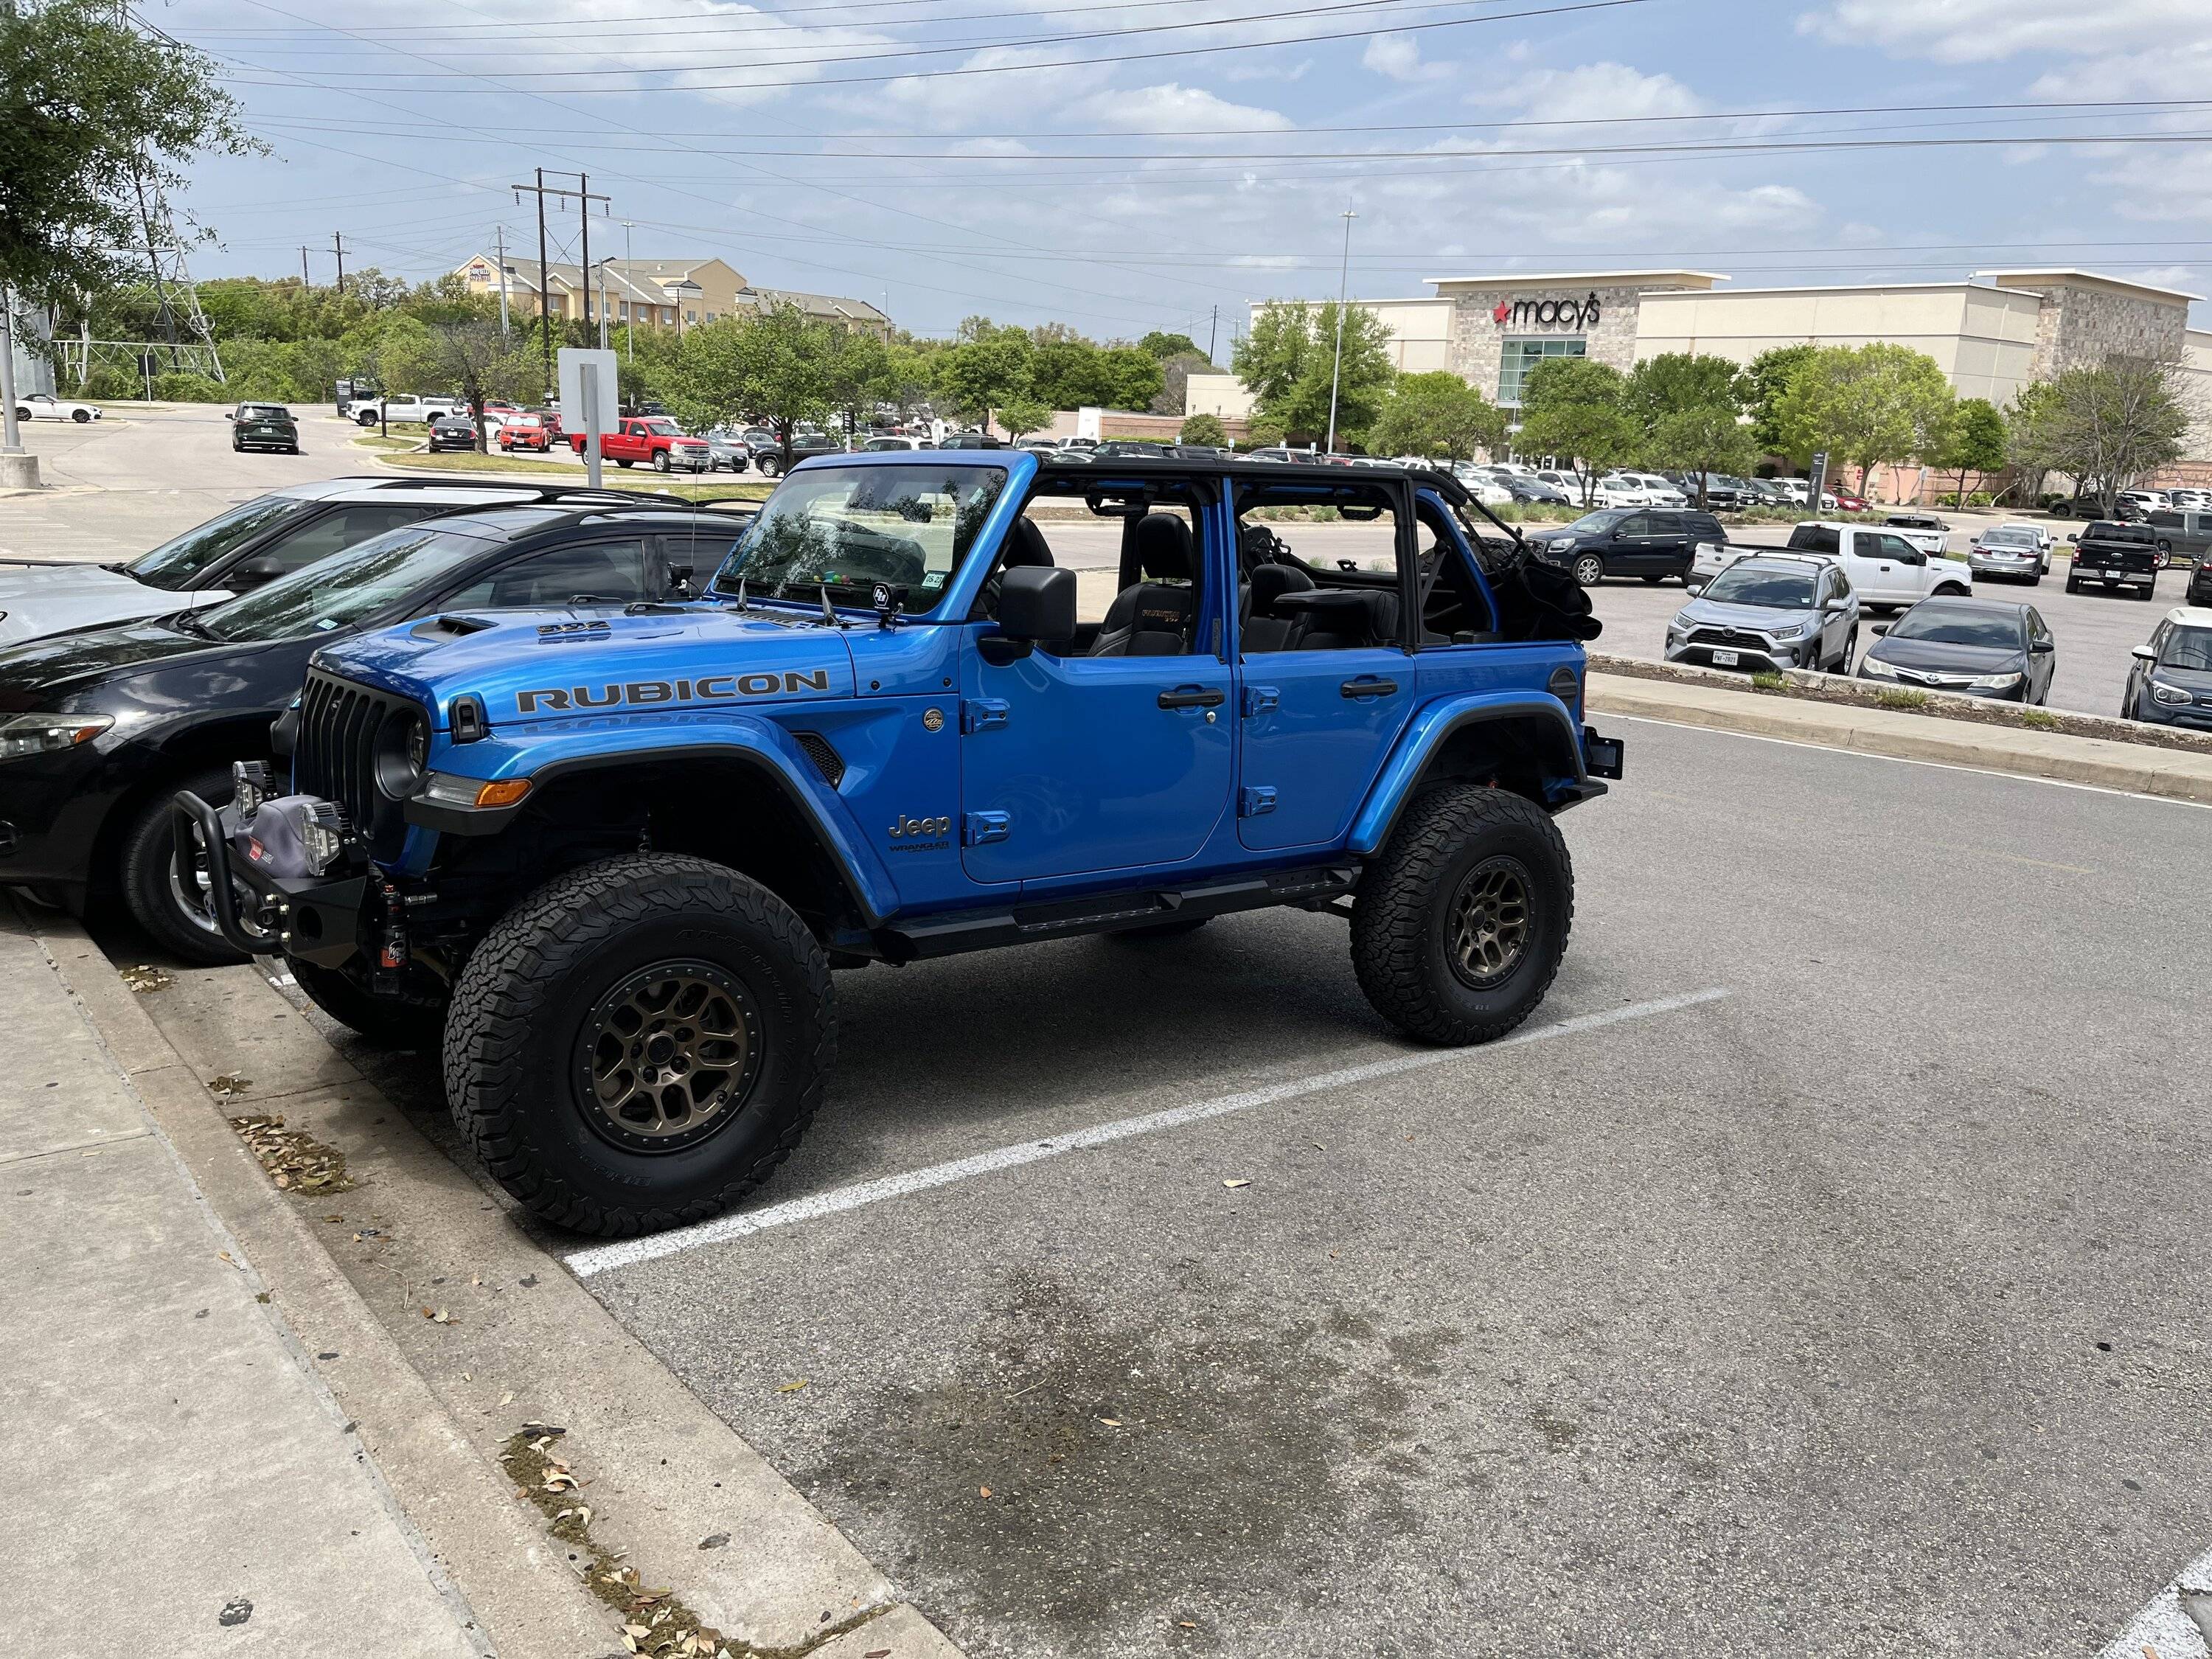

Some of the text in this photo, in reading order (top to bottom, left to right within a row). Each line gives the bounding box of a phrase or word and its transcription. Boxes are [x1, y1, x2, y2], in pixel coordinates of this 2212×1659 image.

[1512, 291, 1601, 330] macy's
[515, 669, 830, 713] RUBICON
[888, 815, 950, 838] Jeep
